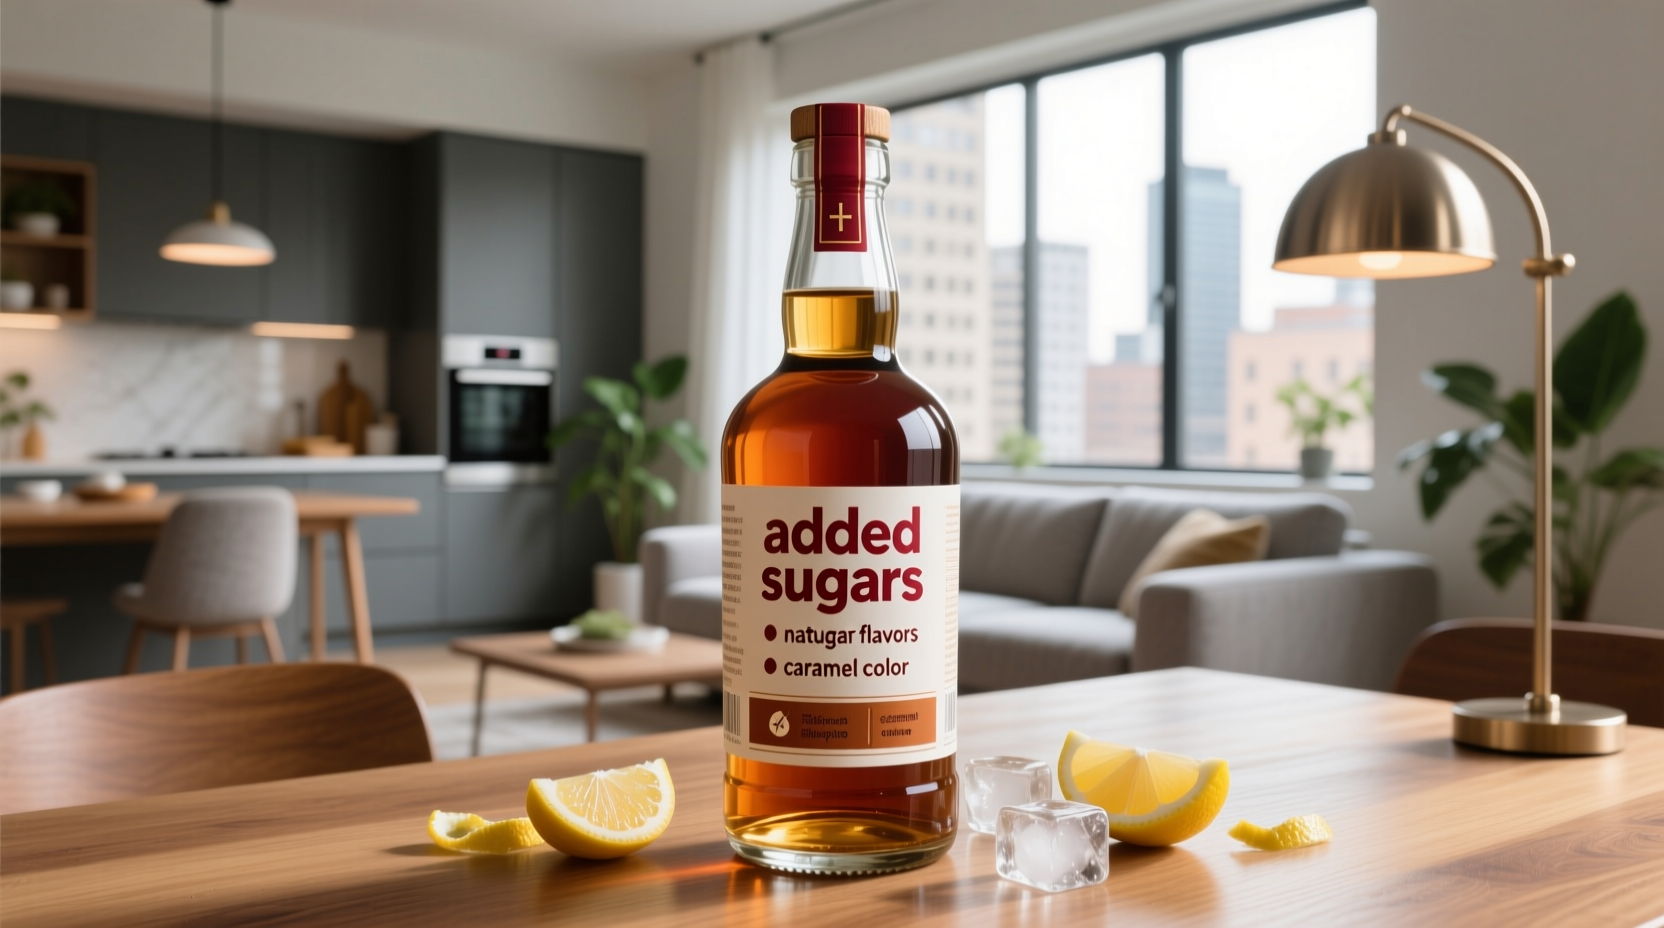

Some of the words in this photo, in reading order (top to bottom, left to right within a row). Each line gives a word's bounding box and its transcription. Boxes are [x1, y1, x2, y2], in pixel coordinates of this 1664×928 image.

[763, 506, 921, 555] added
[761, 566, 923, 615] sugars
[784, 626, 856, 650] natugar
[859, 624, 919, 644] flavors
[783, 657, 858, 677] caramel
[862, 657, 910, 677] color
